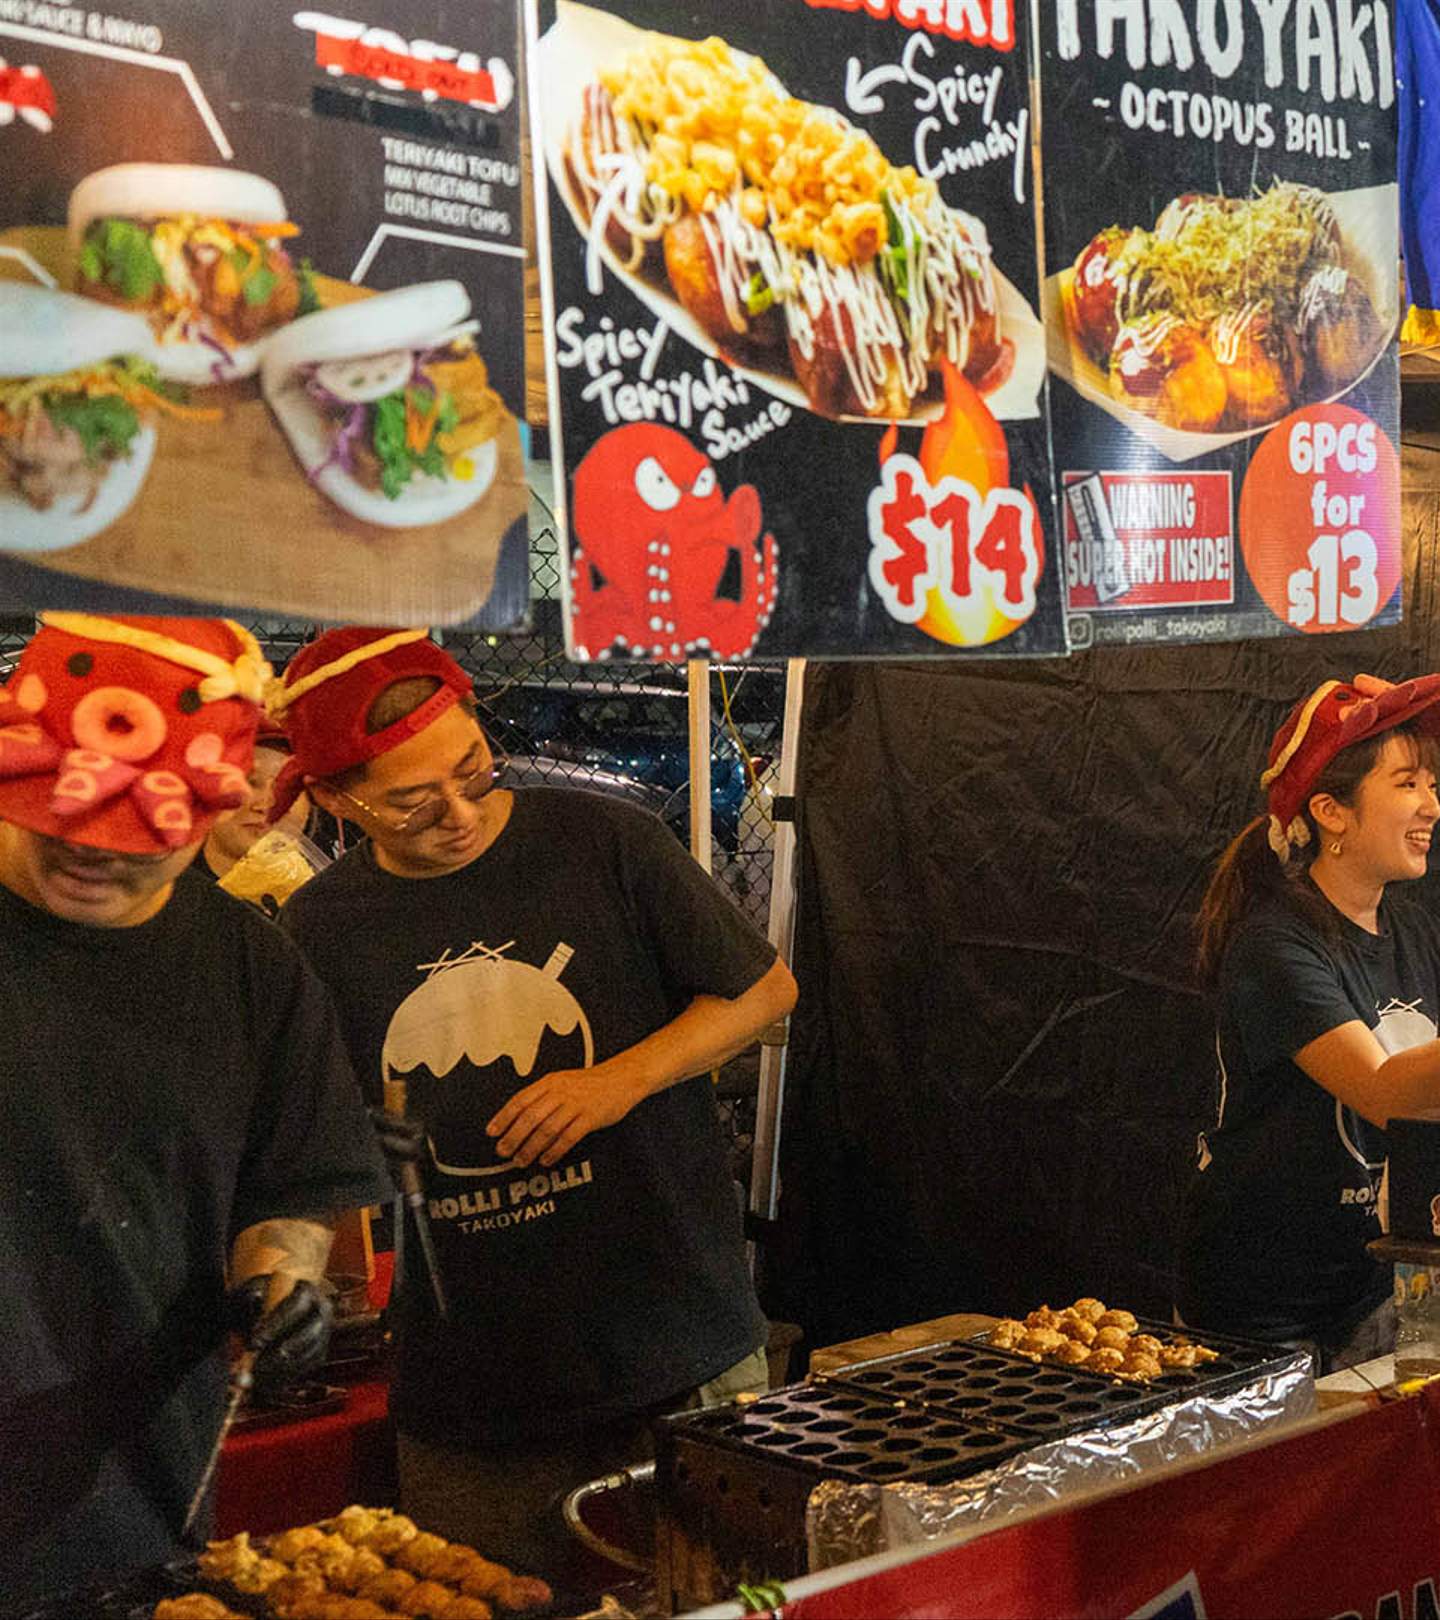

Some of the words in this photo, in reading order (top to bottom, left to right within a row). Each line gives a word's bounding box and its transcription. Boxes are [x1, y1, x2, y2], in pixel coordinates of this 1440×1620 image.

[904, 32, 1002, 126] Spicy
[1120, 82, 1275, 148] OCTOPUS
[1285, 110, 1351, 159] BALL
[381, 136, 467, 176] TERIYAKI
[467, 155, 519, 187] TOFU
[913, 108, 1028, 204] Crunchy
[384, 190, 430, 222] LOTUS
[431, 198, 469, 227] ROOT
[470, 206, 511, 236] CHIPS
[556, 307, 670, 379] Spicy
[582, 359, 750, 427] Teriyaki
[702, 400, 791, 460] Sauce
[1288, 420, 1378, 475] 6PCS
[1109, 483, 1196, 530] WARNING
[1311, 480, 1366, 528] for
[874, 460, 1035, 615] $14
[1067, 538, 1127, 588] SUPER
[1129, 537, 1166, 584] HOT
[1170, 535, 1231, 583] INSIDE!
[1287, 529, 1379, 627] $13
[509, 1160, 594, 1205] POLLI
[458, 1200, 556, 1236] TAKOYAKI
